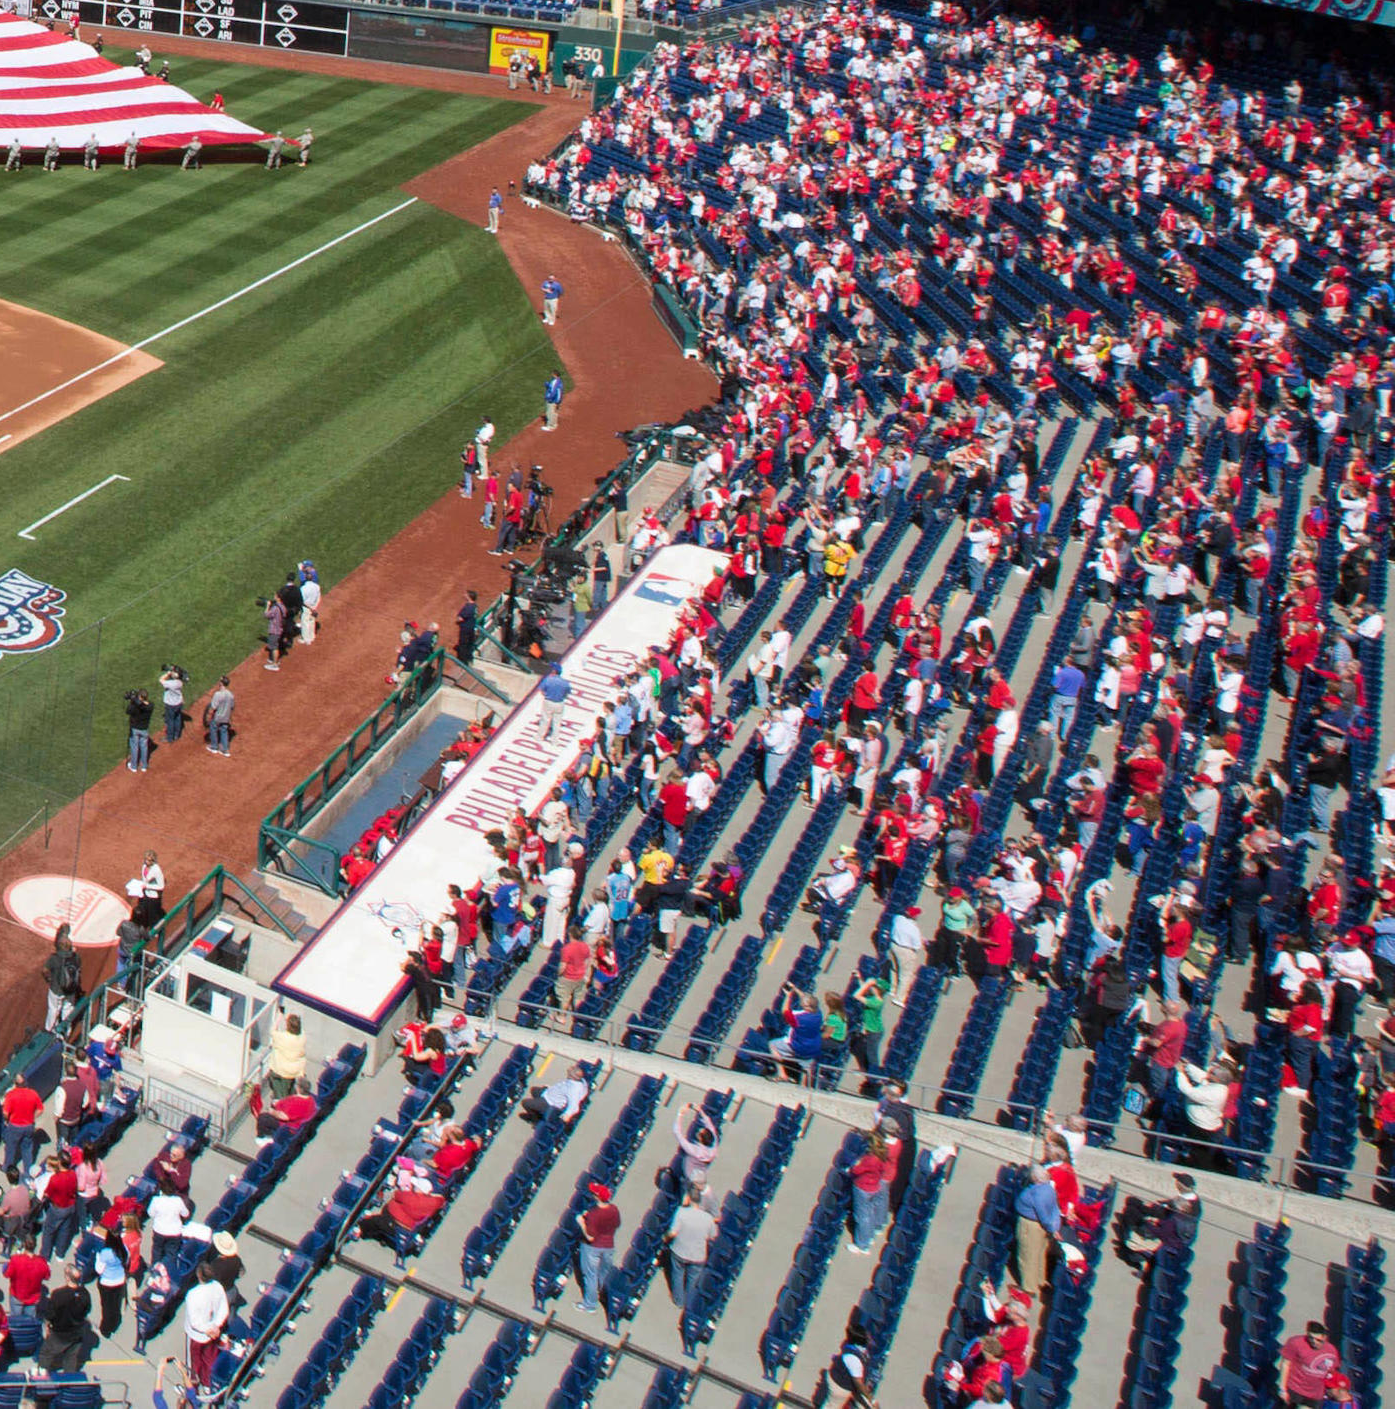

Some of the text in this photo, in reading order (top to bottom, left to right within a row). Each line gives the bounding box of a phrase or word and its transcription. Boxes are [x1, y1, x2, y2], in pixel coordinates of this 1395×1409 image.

[62, 0, 79, 10] NYM
[140, 9, 153, 19] PIT
[218, 6, 234, 17] LAD
[139, 20, 152, 30] CIN
[220, 19, 231, 29] SF
[217, 30, 232, 40] ARI
[574, 46, 602, 62] 330
[564, 643, 638, 714] PHILLIES
